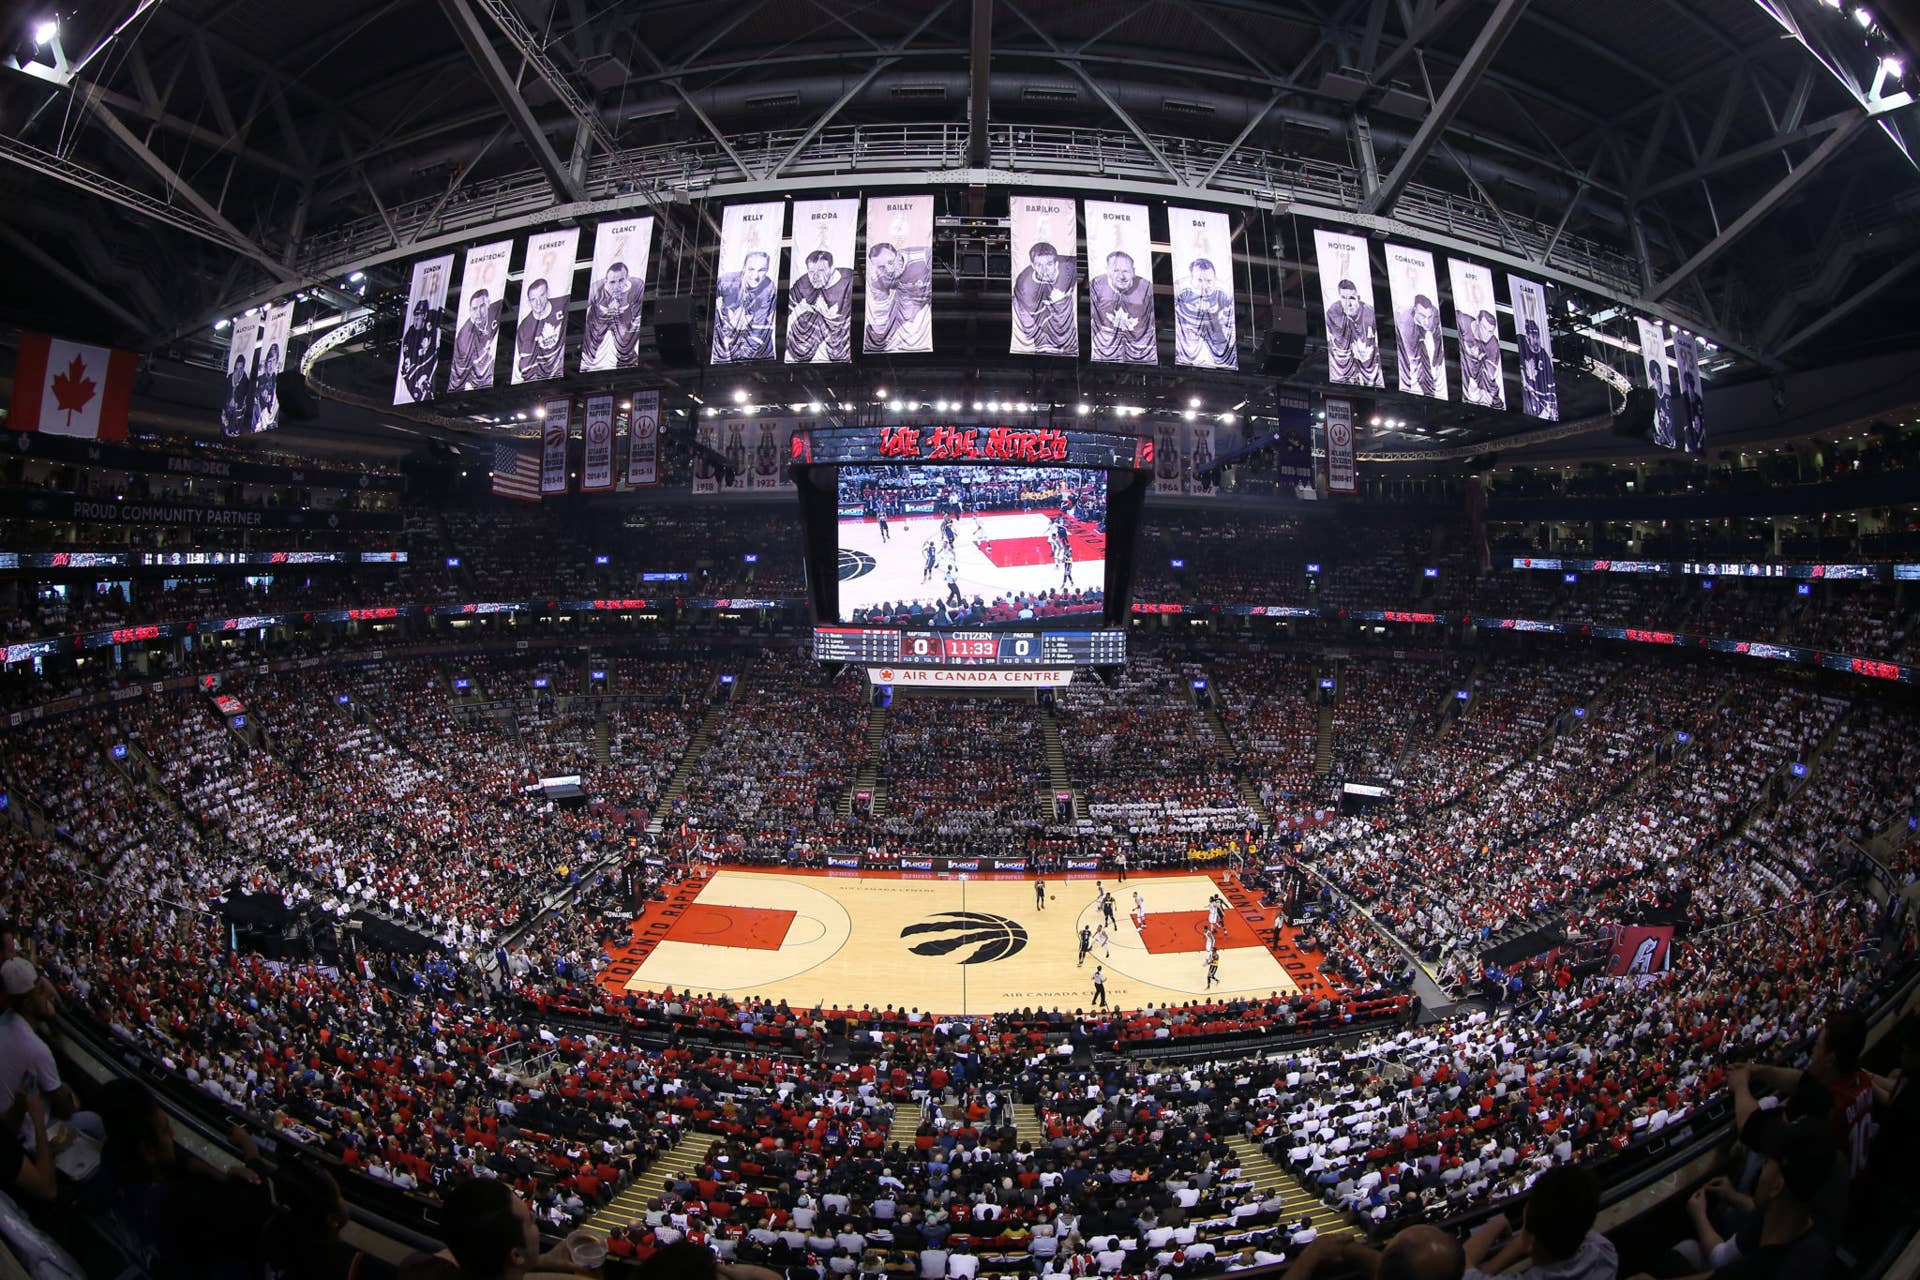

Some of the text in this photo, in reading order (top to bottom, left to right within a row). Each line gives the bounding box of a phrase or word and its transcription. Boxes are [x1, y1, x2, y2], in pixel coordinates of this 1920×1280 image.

[1025, 205, 1060, 214] BARILKO
[743, 214, 764, 222] KELLY
[811, 213, 838, 221] BRODA
[1103, 213, 1131, 221] BOWER
[1192, 220, 1206, 228] DAY
[612, 225, 636, 235] CLANCY
[538, 240, 566, 250] KENNEDY
[1328, 241, 1355, 252] HORTON
[470, 252, 506, 265] ARMSTRONG
[1395, 254, 1425, 267] CONACHER
[423, 264, 442, 275] SUNDIN
[1520, 285, 1534, 294] CLARK
[168, 457, 231, 476] FAN DECK
[757, 480, 776, 488] 1932
[74, 502, 262, 525] PROUD COMMUNITY PARTNER
[952, 632, 992, 640] CITIZEN
[914, 639, 928, 655] 0
[951, 642, 993, 655] 11:33
[1015, 640, 1029, 656] 0
[903, 671, 1060, 681] AIR CANADA CENTRE
[604, 922, 670, 984] TORONTO
